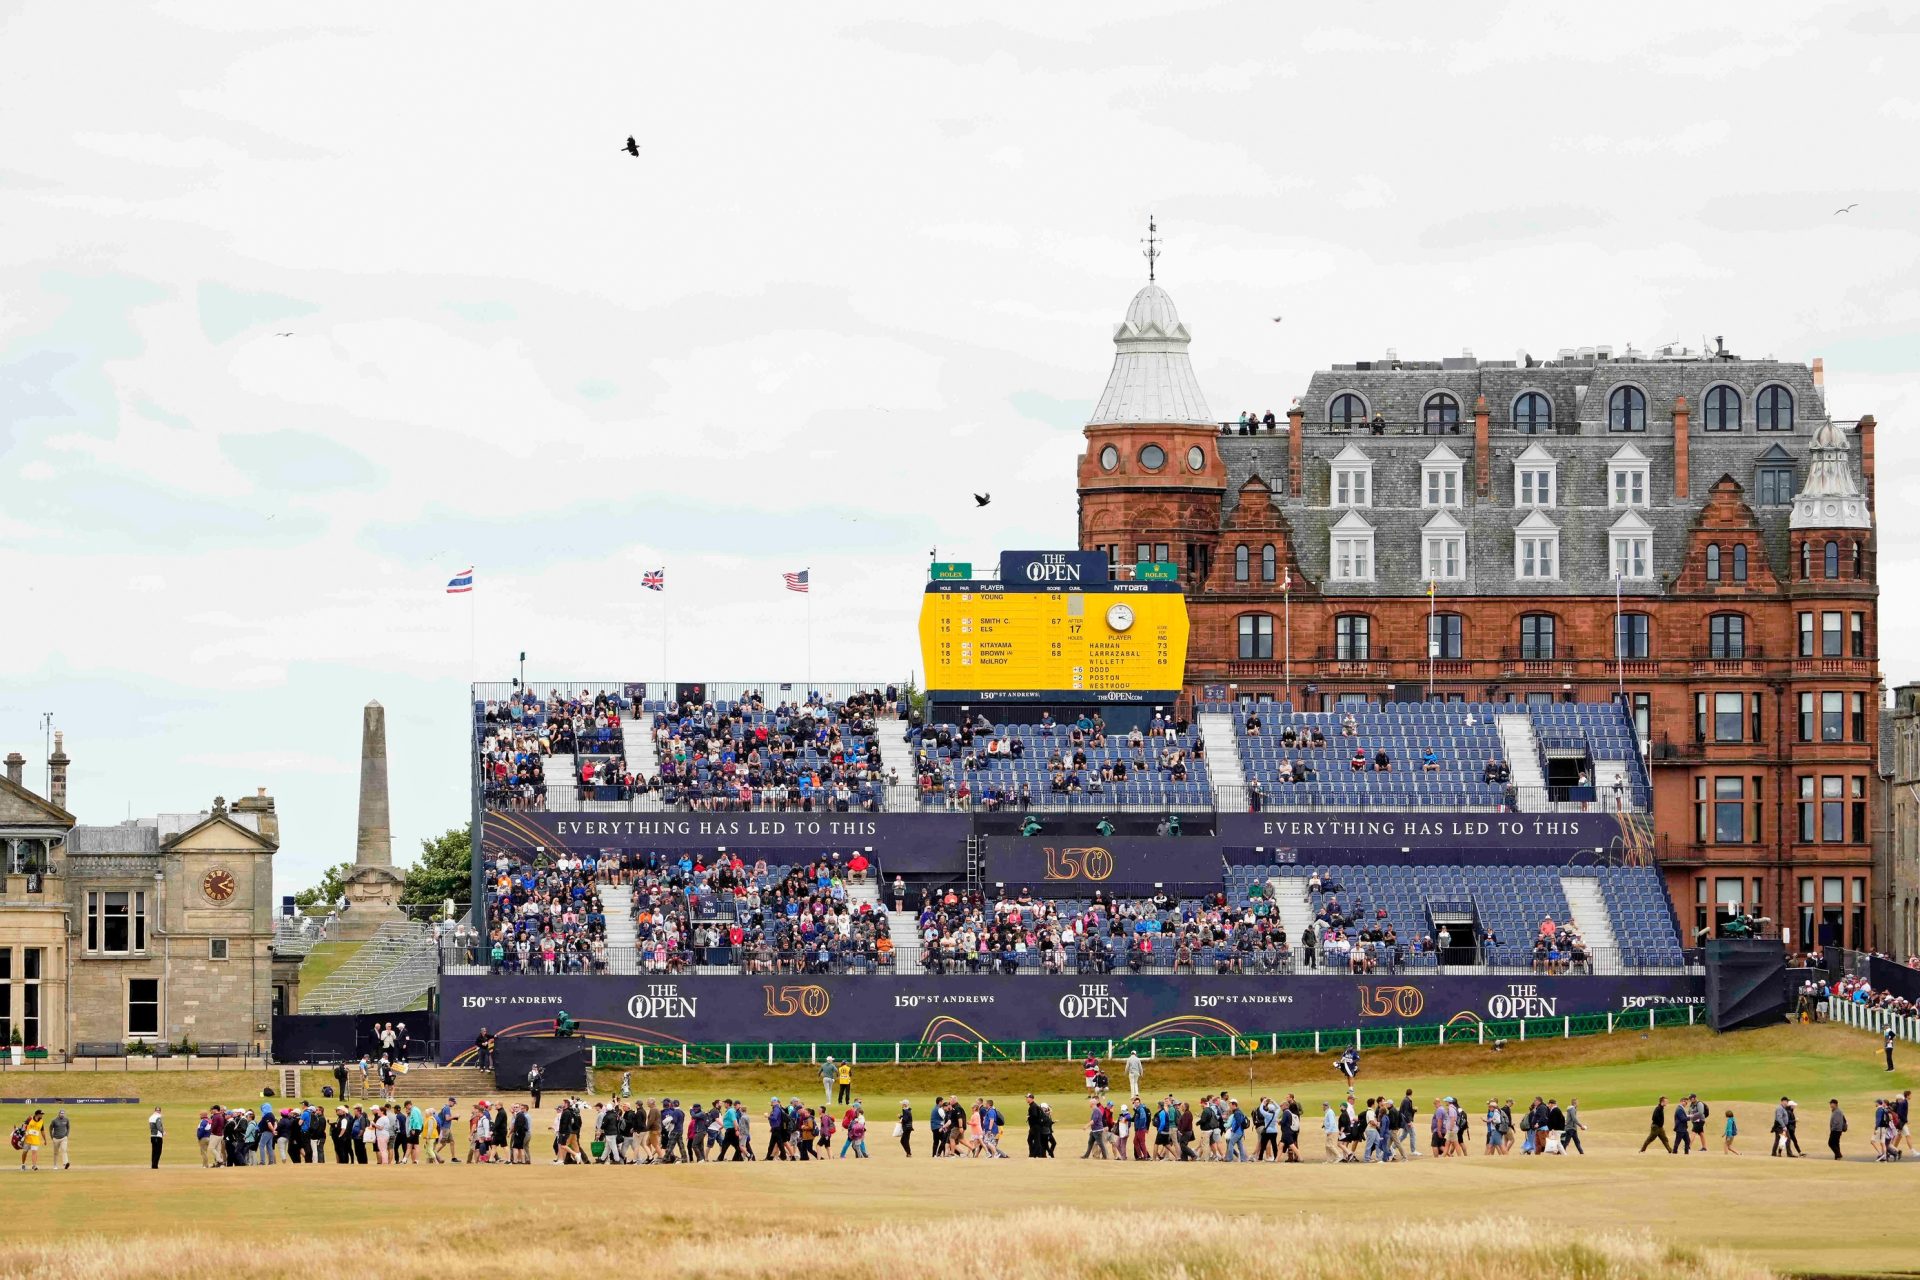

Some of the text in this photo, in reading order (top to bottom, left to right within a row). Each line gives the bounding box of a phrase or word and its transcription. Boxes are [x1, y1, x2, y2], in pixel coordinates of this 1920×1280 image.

[1042, 554, 1066, 564] THE
[1026, 562, 1081, 581] OPEN
[558, 821, 876, 835] EVERYTHING HAS LED TO THIS
[1264, 821, 1579, 835] EVERYTHING HAS LED TO THIS
[648, 984, 678, 996] THE
[1080, 984, 1108, 996] THE
[1508, 984, 1537, 996] THE
[462, 996, 493, 1008] 150TH
[628, 994, 698, 1019] OPEN
[894, 995, 925, 1007] 150TH
[1060, 994, 1128, 1018] OPEN
[1193, 995, 1224, 1007] 150TH
[1488, 994, 1556, 1018] OPEN
[1622, 996, 1652, 1008] 150TH
